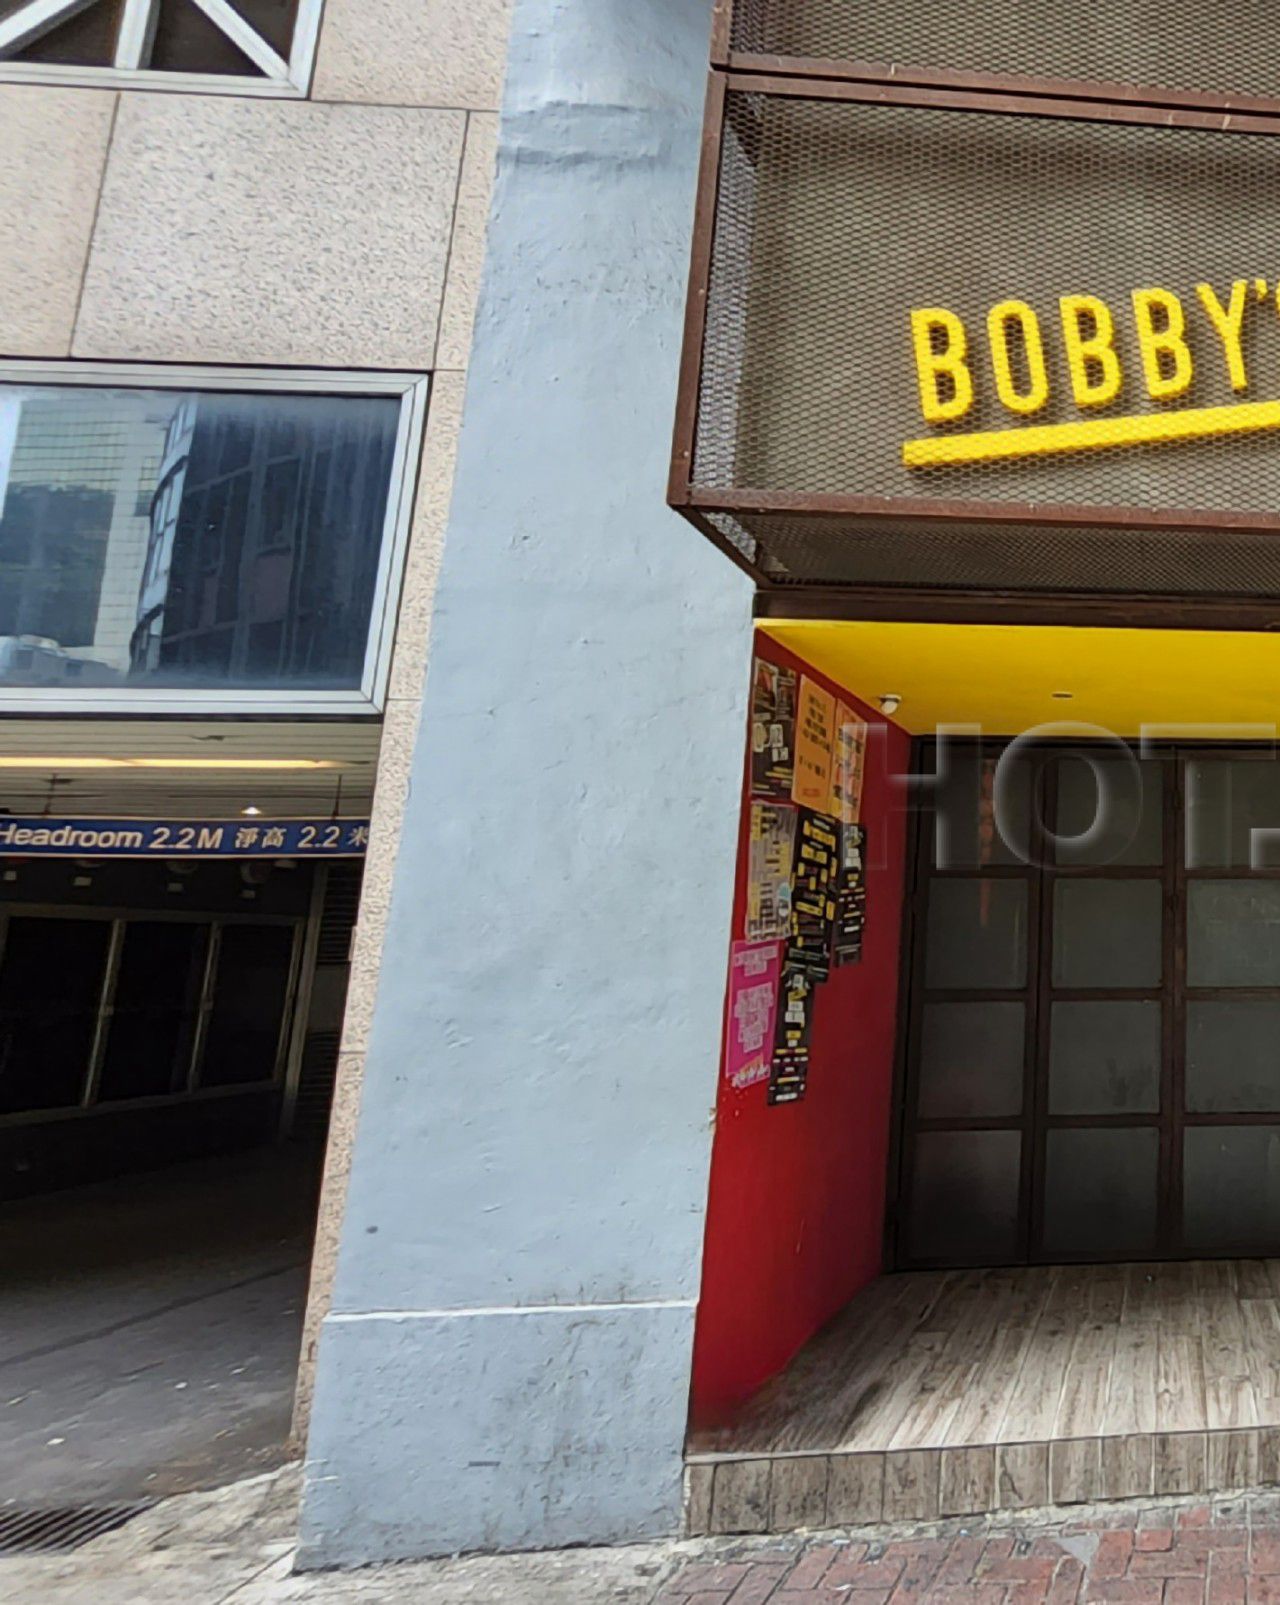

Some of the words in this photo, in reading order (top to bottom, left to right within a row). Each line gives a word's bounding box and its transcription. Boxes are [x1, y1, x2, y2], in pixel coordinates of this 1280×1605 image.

[0, 823, 143, 849] Headroom
[234, 827, 287, 848] 淨高
[297, 825, 340, 848] 2.2
[348, 826, 369, 847] 米
